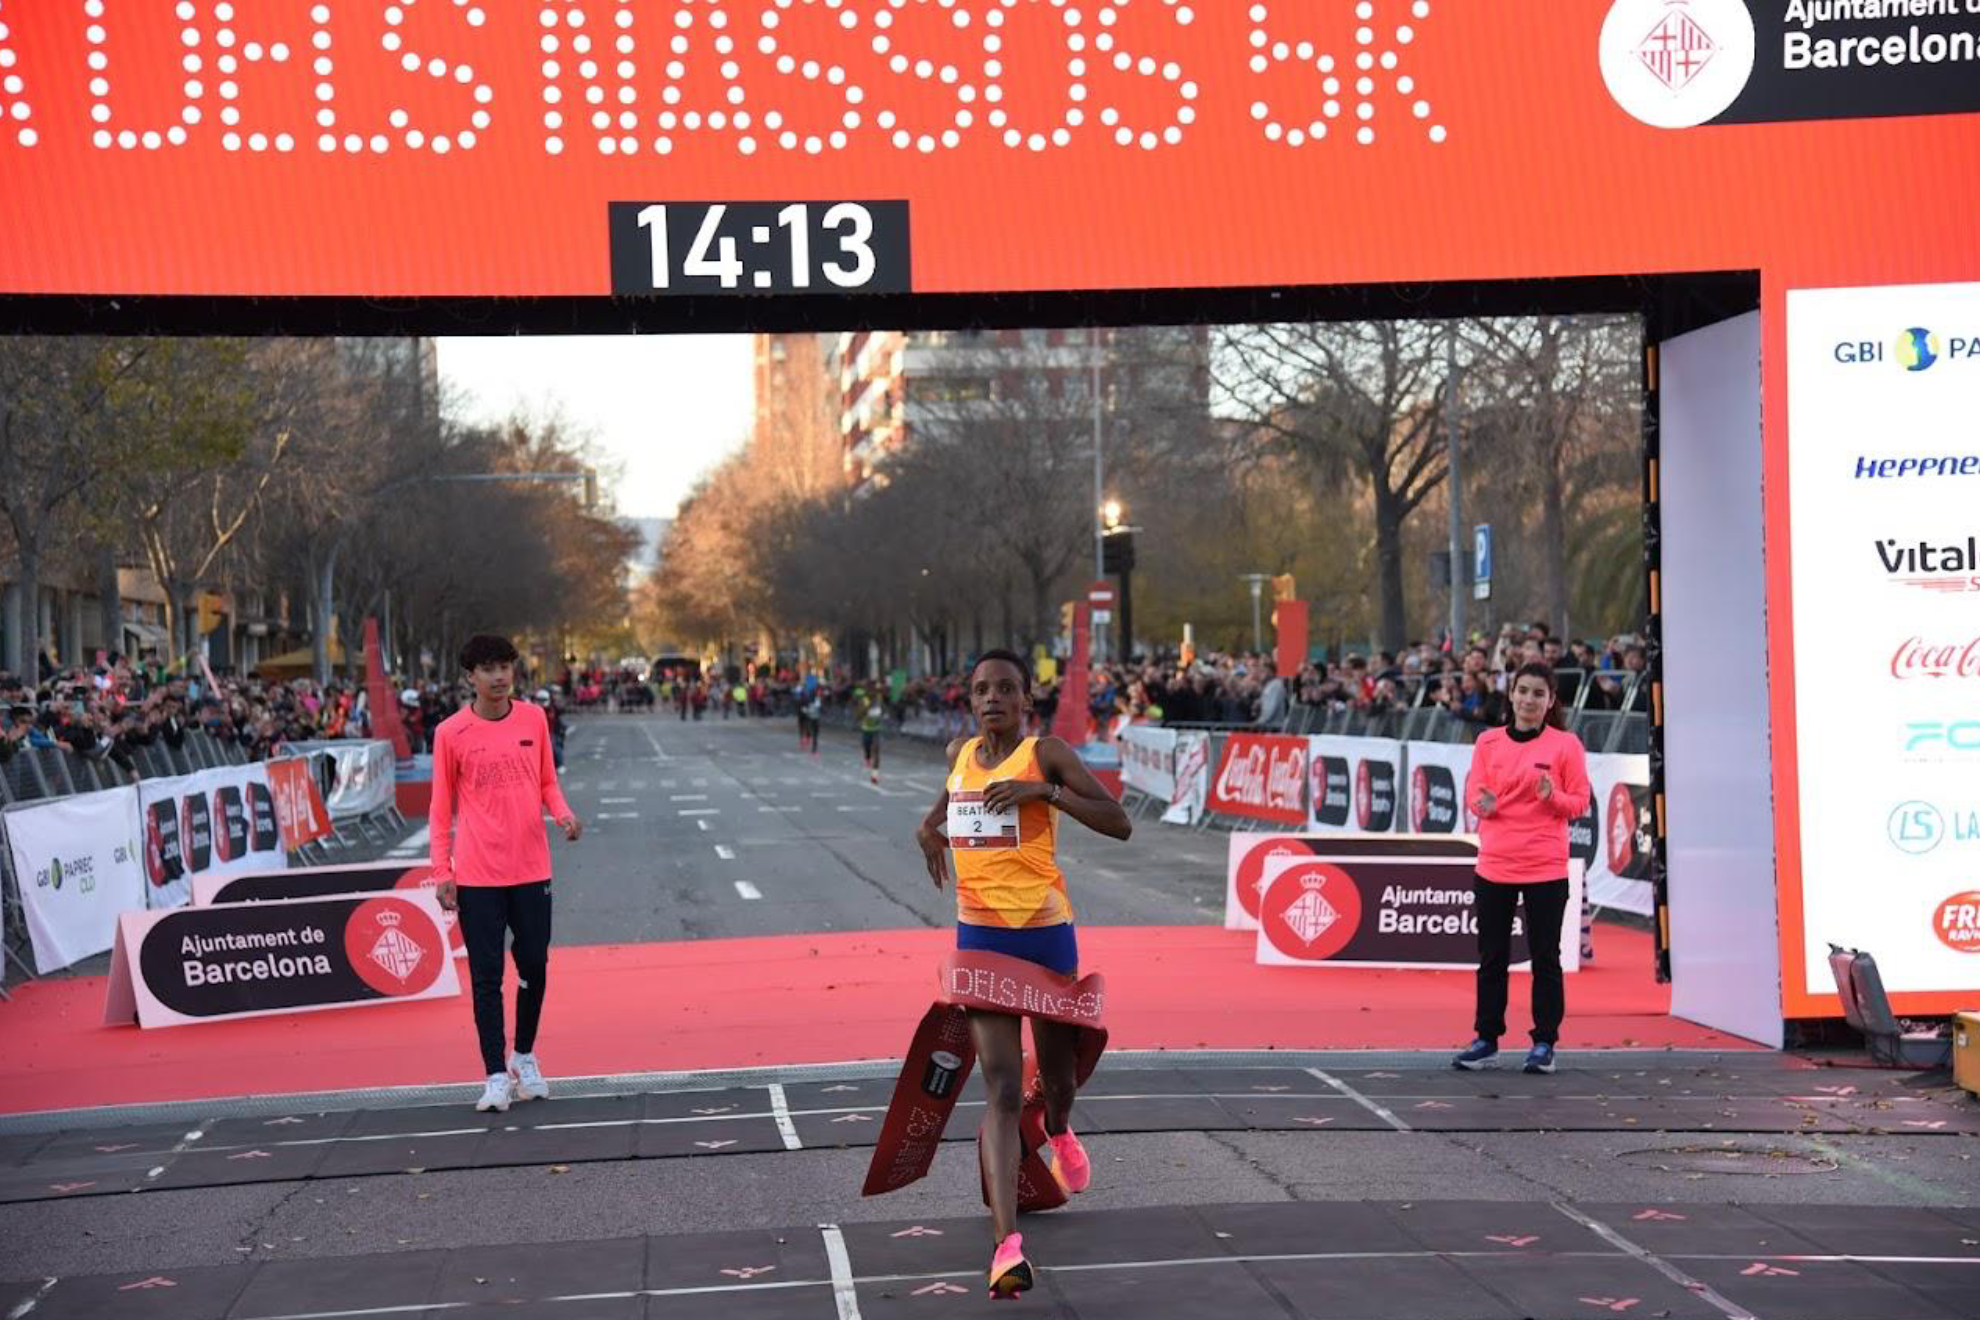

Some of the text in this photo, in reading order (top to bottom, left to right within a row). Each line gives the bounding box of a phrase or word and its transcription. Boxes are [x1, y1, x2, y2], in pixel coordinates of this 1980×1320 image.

[1784, 26, 1980, 69] Barcelon
[85, 0, 492, 152] DELS
[540, 0, 1197, 154] NASSOS
[1249, 0, 1446, 145] 5K
[638, 203, 876, 288] 14:13
[1834, 337, 1980, 363] GBI PA
[1875, 537, 1980, 573] Vital
[973, 820, 983, 833] 2
[1954, 809, 1980, 841] LA
[1381, 885, 1476, 908] Ajuntame
[181, 926, 325, 957] Ajuntament de
[183, 953, 332, 986] Barcelona
[952, 967, 1017, 1007] DELS
